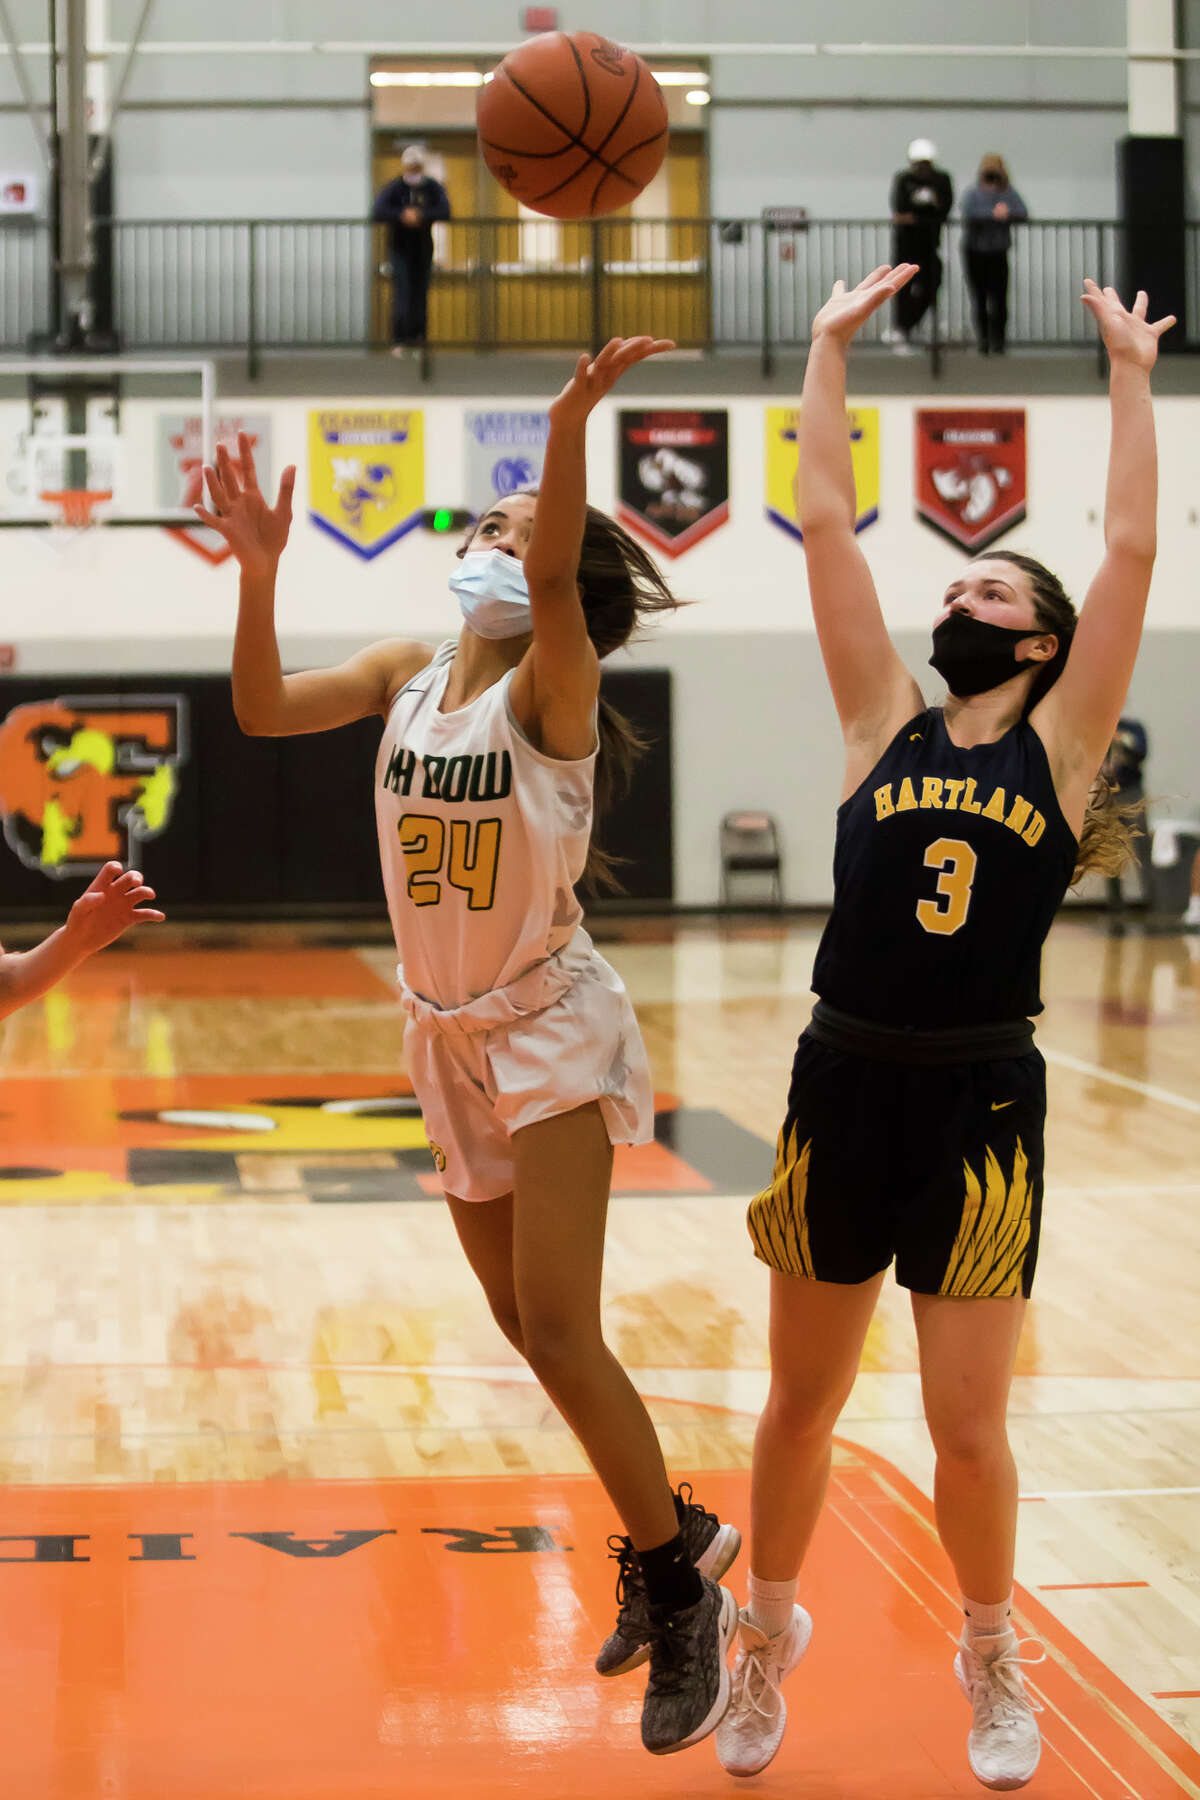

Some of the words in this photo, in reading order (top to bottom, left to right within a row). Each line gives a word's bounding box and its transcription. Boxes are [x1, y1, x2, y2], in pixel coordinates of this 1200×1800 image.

[421, 749, 512, 803] DOW
[873, 776, 1046, 847] HARTLAND
[398, 813, 502, 911] 24
[916, 837, 977, 936] 3
